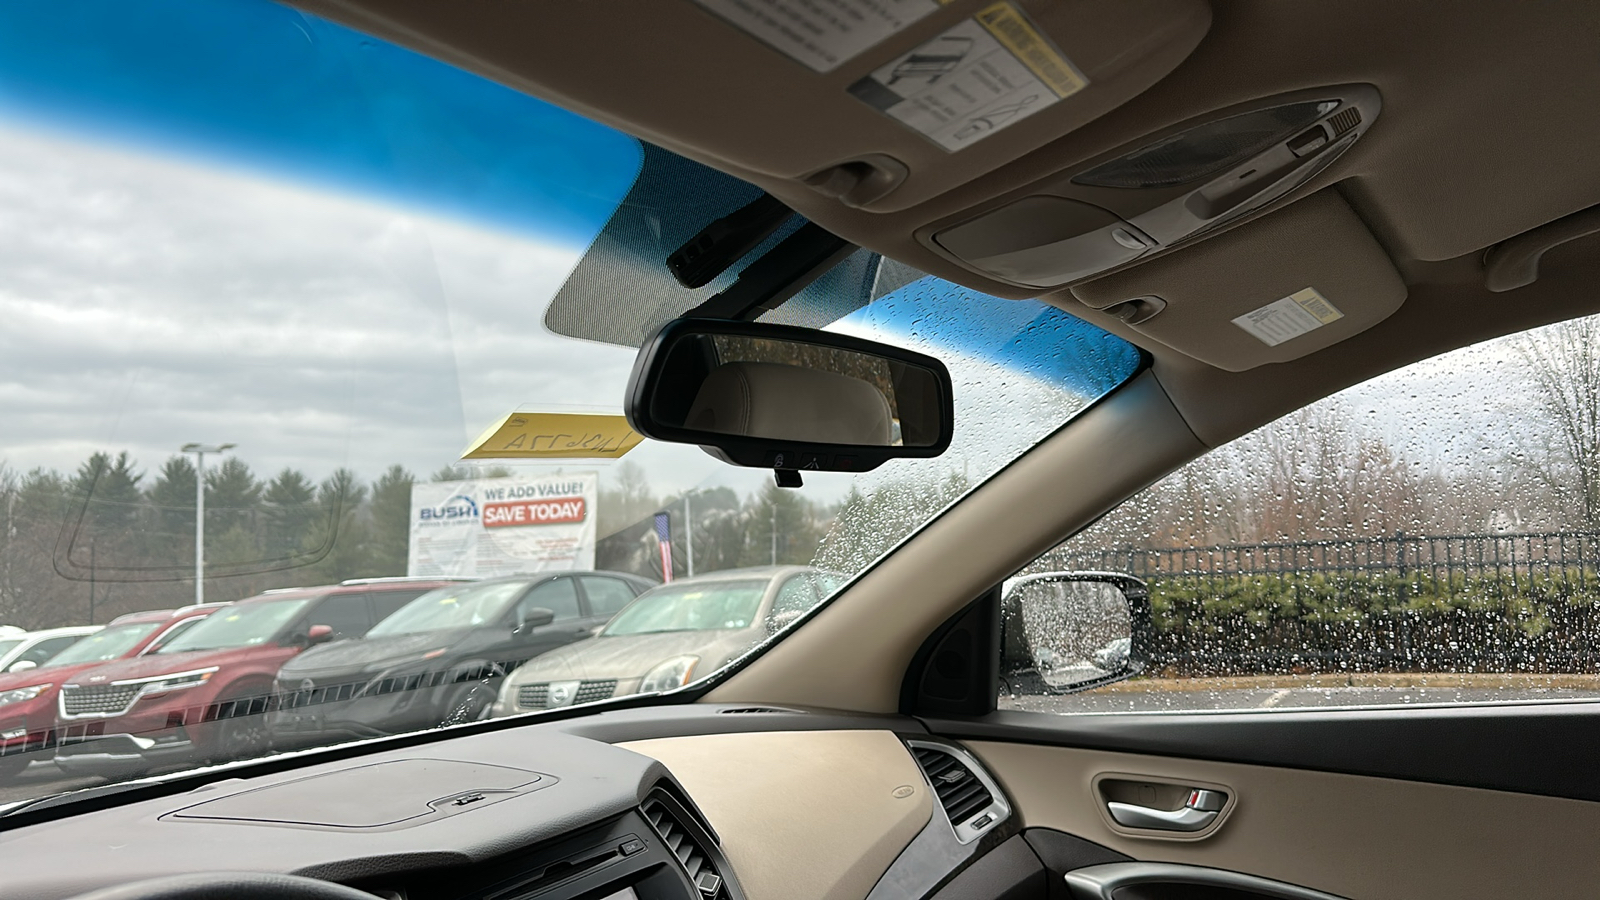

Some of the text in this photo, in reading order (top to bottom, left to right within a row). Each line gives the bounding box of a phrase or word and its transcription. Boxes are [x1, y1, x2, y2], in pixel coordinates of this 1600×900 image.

[485, 483, 584, 500] WE ADD VALUE!
[420, 506, 472, 519] BUSH
[484, 501, 582, 523] SAVE TODAY
